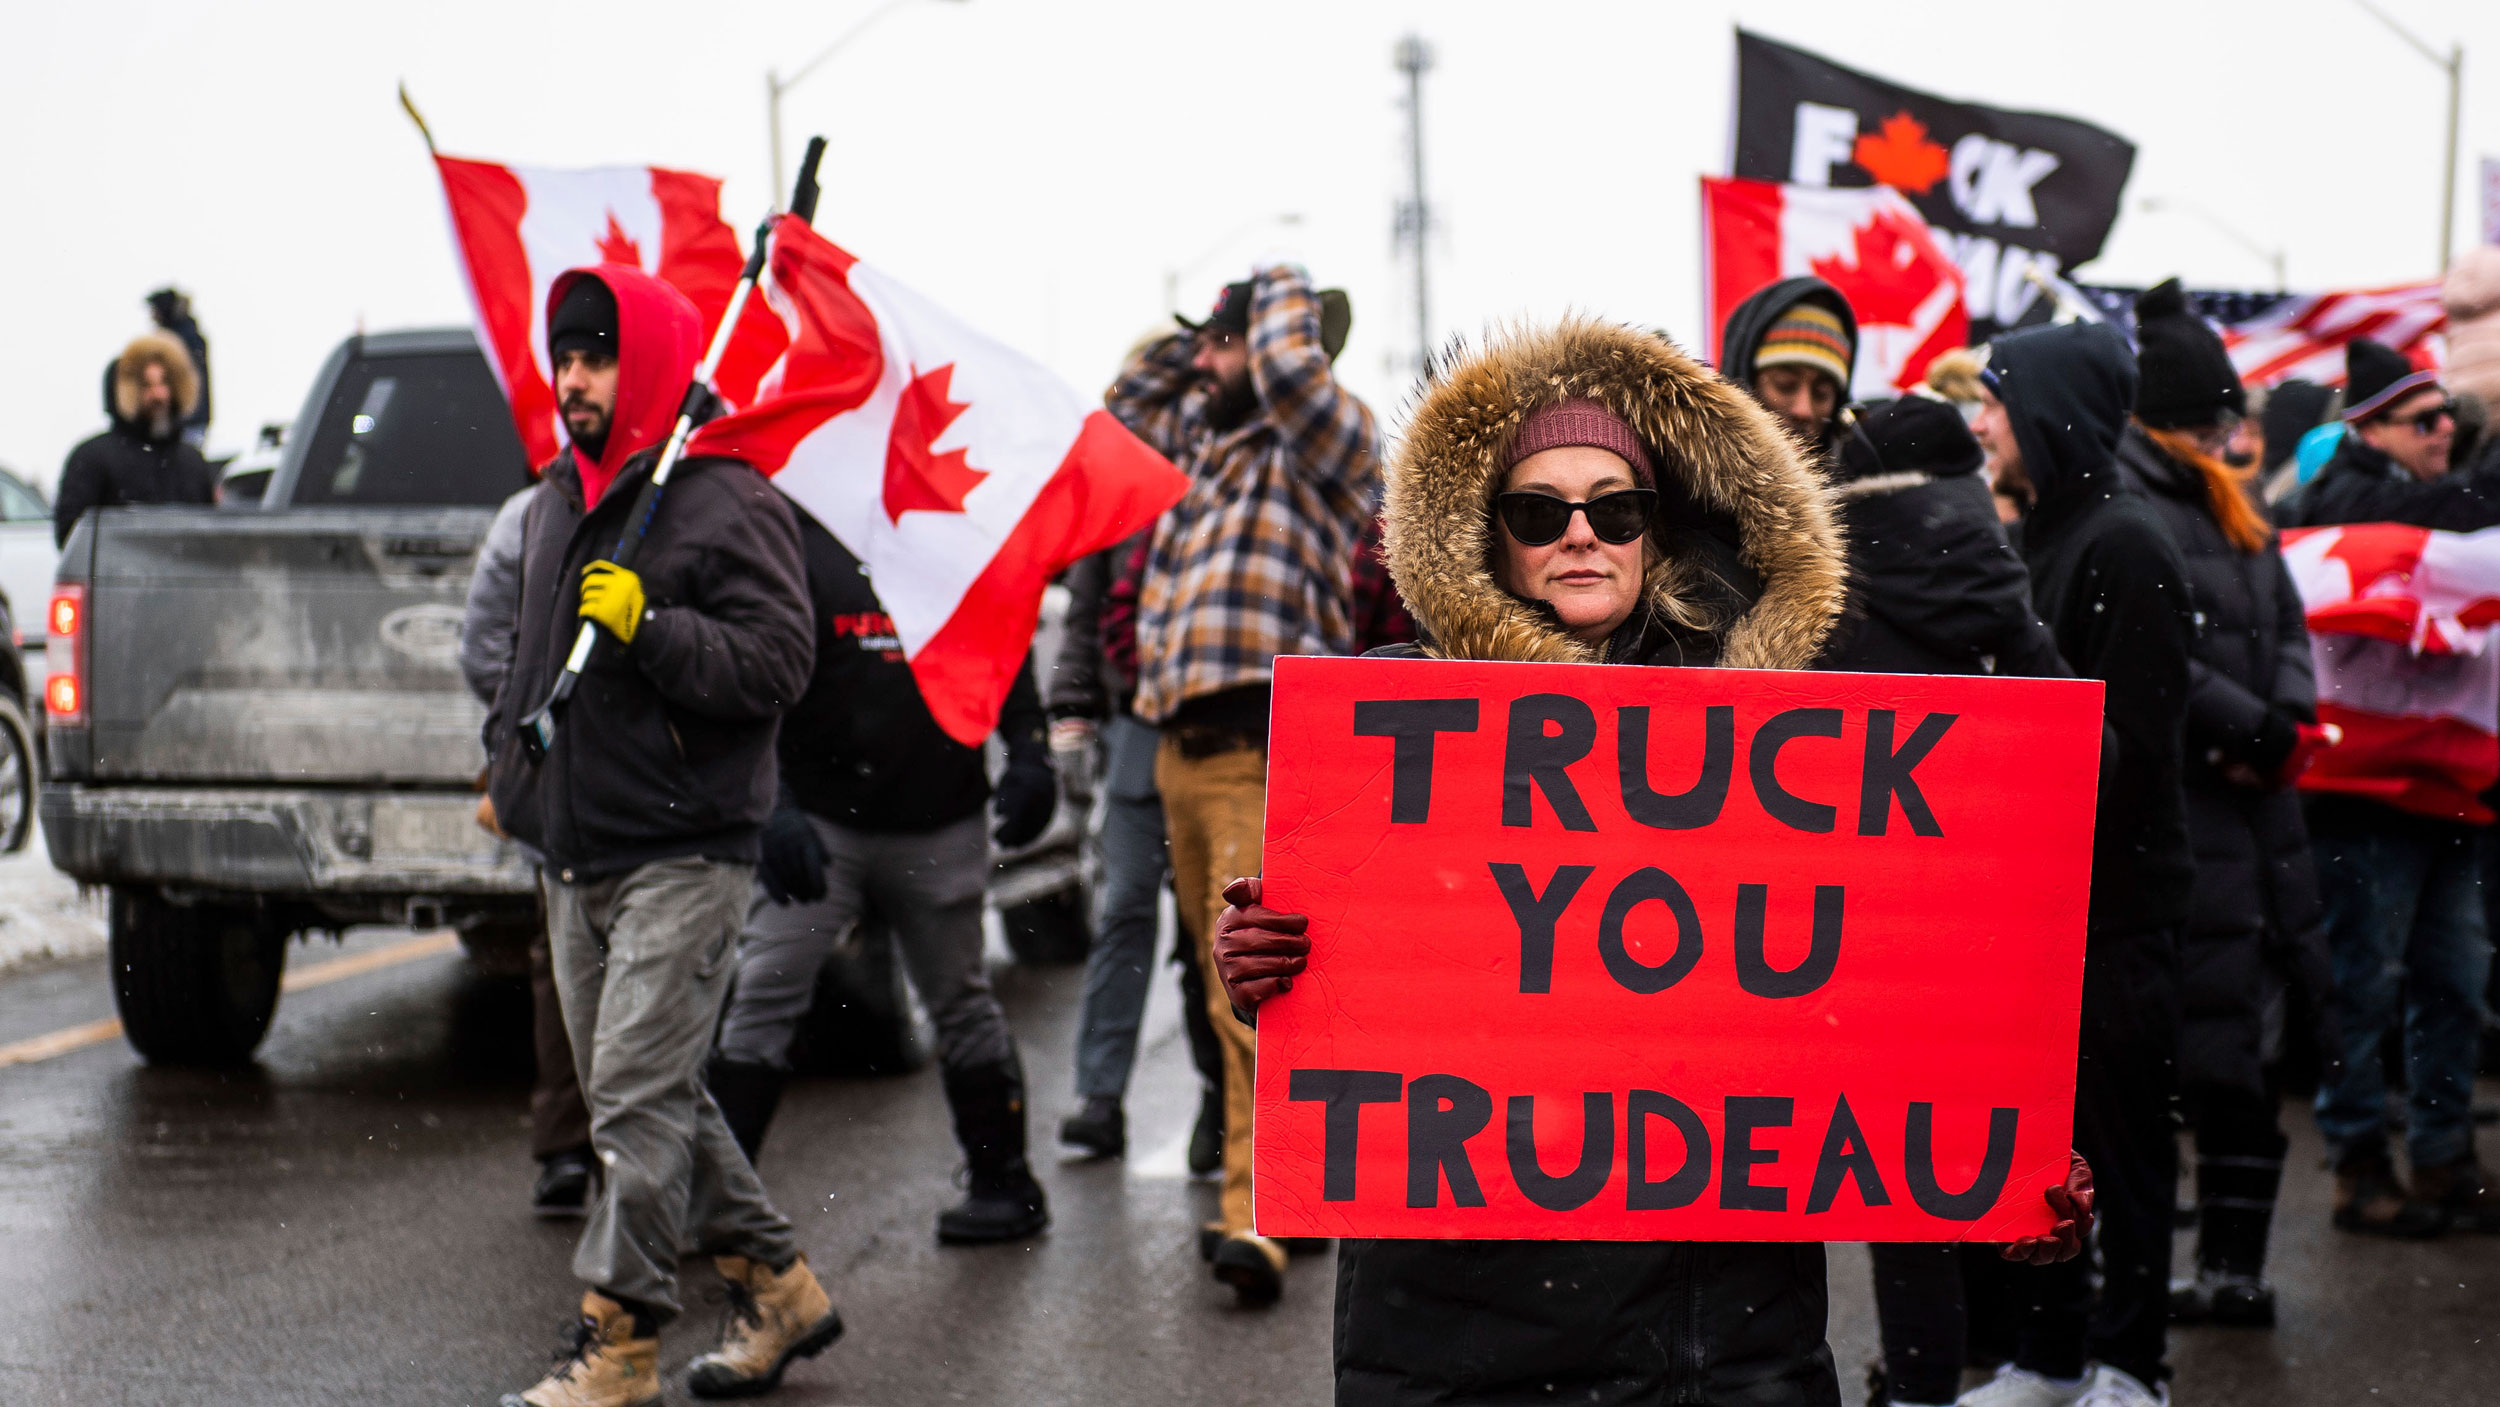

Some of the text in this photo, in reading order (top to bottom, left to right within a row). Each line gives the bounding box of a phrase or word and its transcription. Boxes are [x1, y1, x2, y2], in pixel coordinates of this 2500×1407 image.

[1791, 102, 2059, 227] FCK
[1354, 693, 1959, 837] TRUCK
[1488, 862, 1844, 998] YOU
[1289, 1069, 2019, 1221] TRUDEAU
